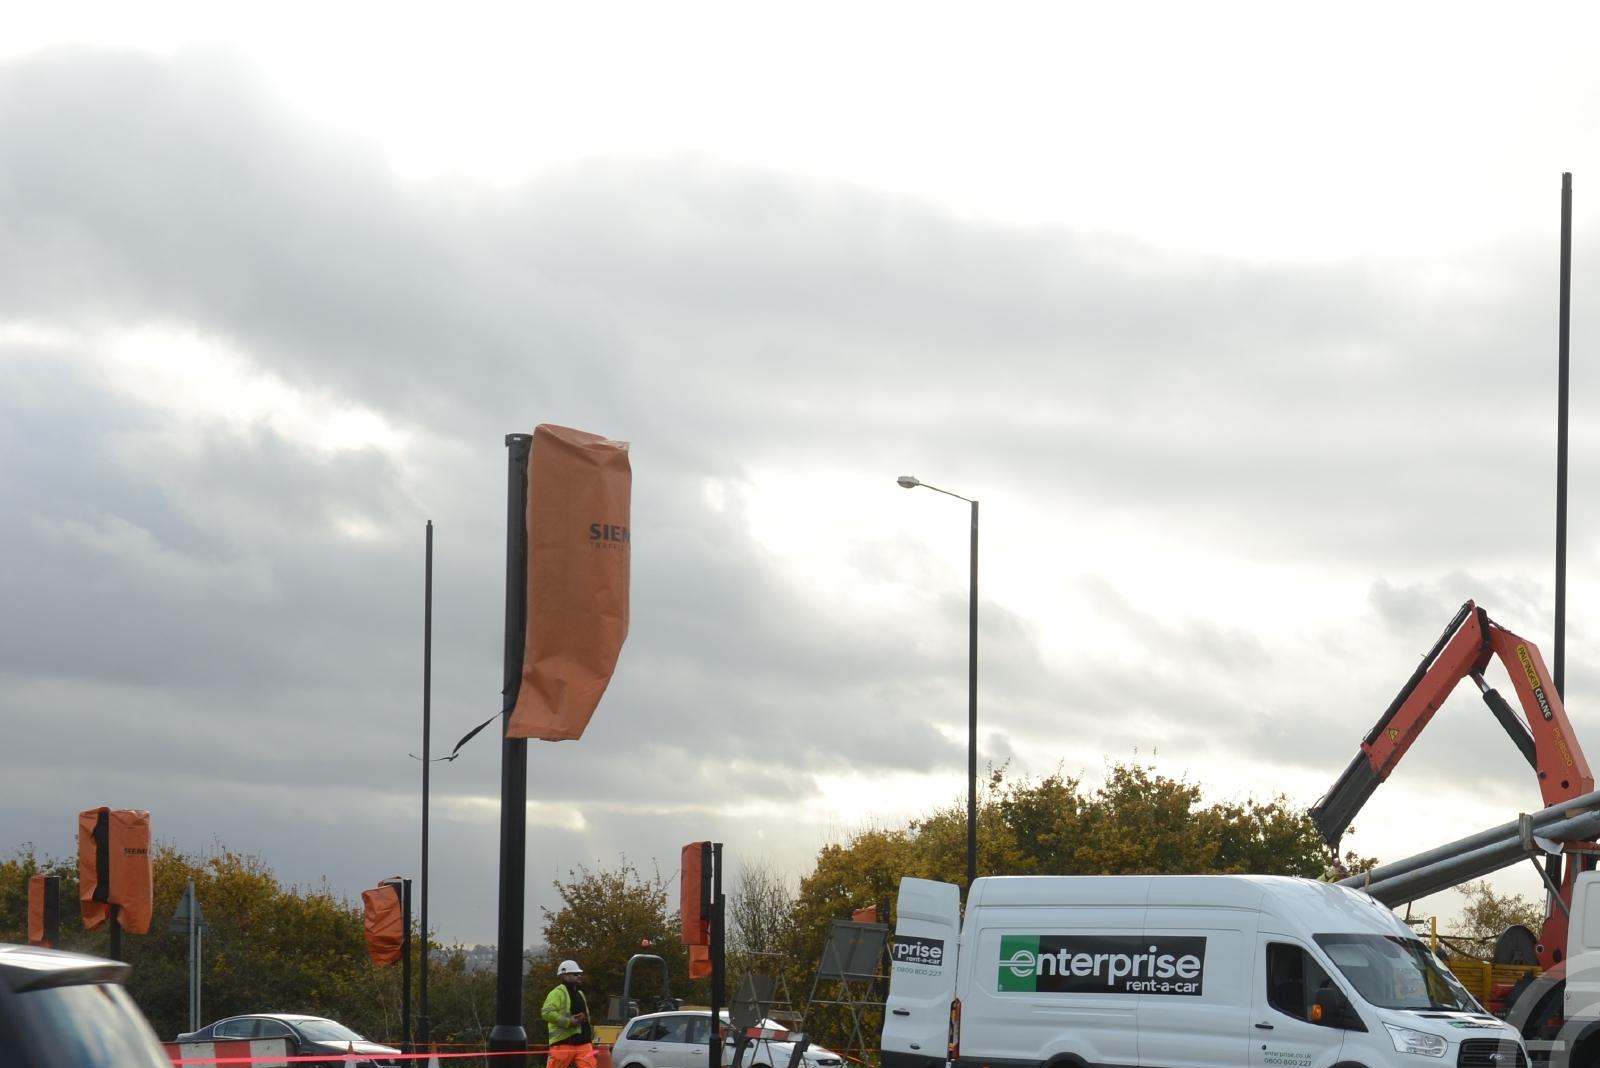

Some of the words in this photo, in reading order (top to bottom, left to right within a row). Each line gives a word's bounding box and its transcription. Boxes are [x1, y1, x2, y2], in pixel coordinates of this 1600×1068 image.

[1519, 646, 1540, 689] PALFINGER
[1534, 687, 1552, 719] CRANE
[999, 945, 1201, 986] enterprise
[1126, 979, 1199, 993] rent-a-car
